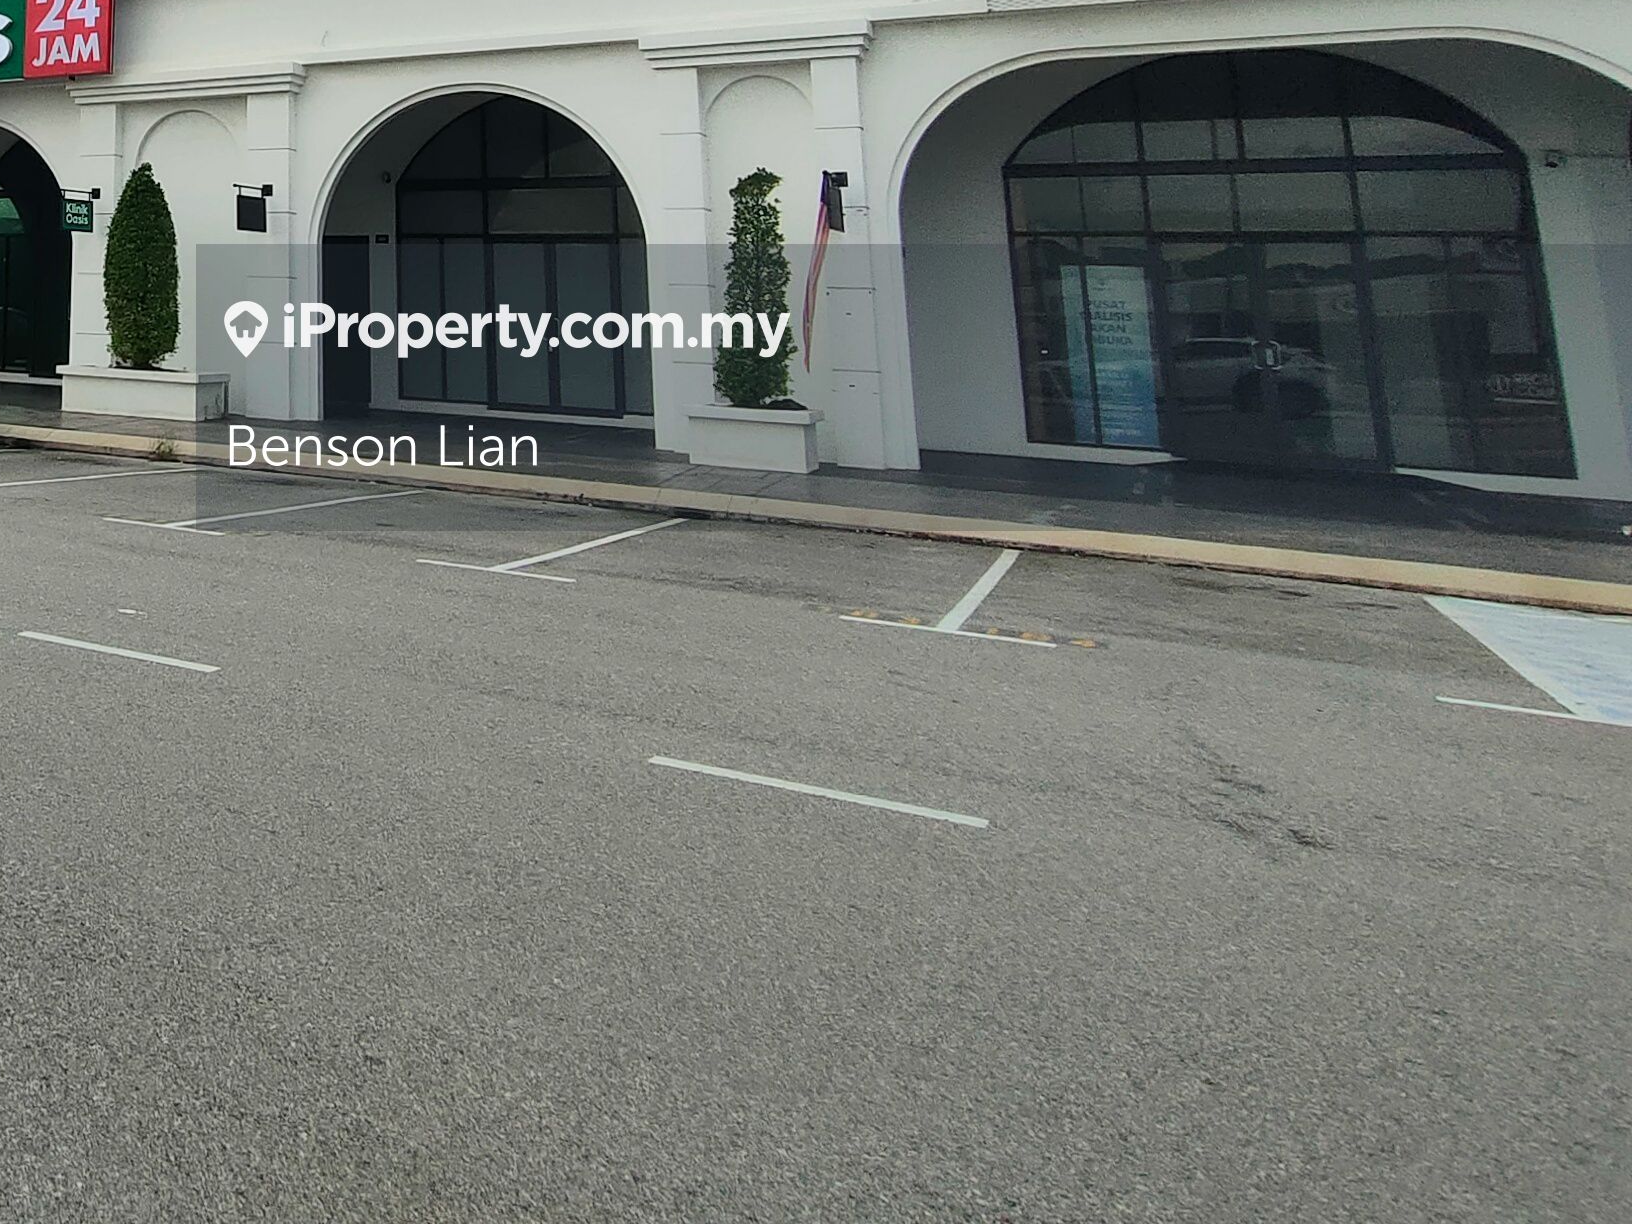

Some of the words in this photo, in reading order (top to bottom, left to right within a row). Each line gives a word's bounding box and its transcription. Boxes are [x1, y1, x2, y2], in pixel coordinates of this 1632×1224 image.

[32, 32, 101, 67] JAM
[65, 202, 89, 216] Klinik
[65, 213, 89, 225] Oasis
